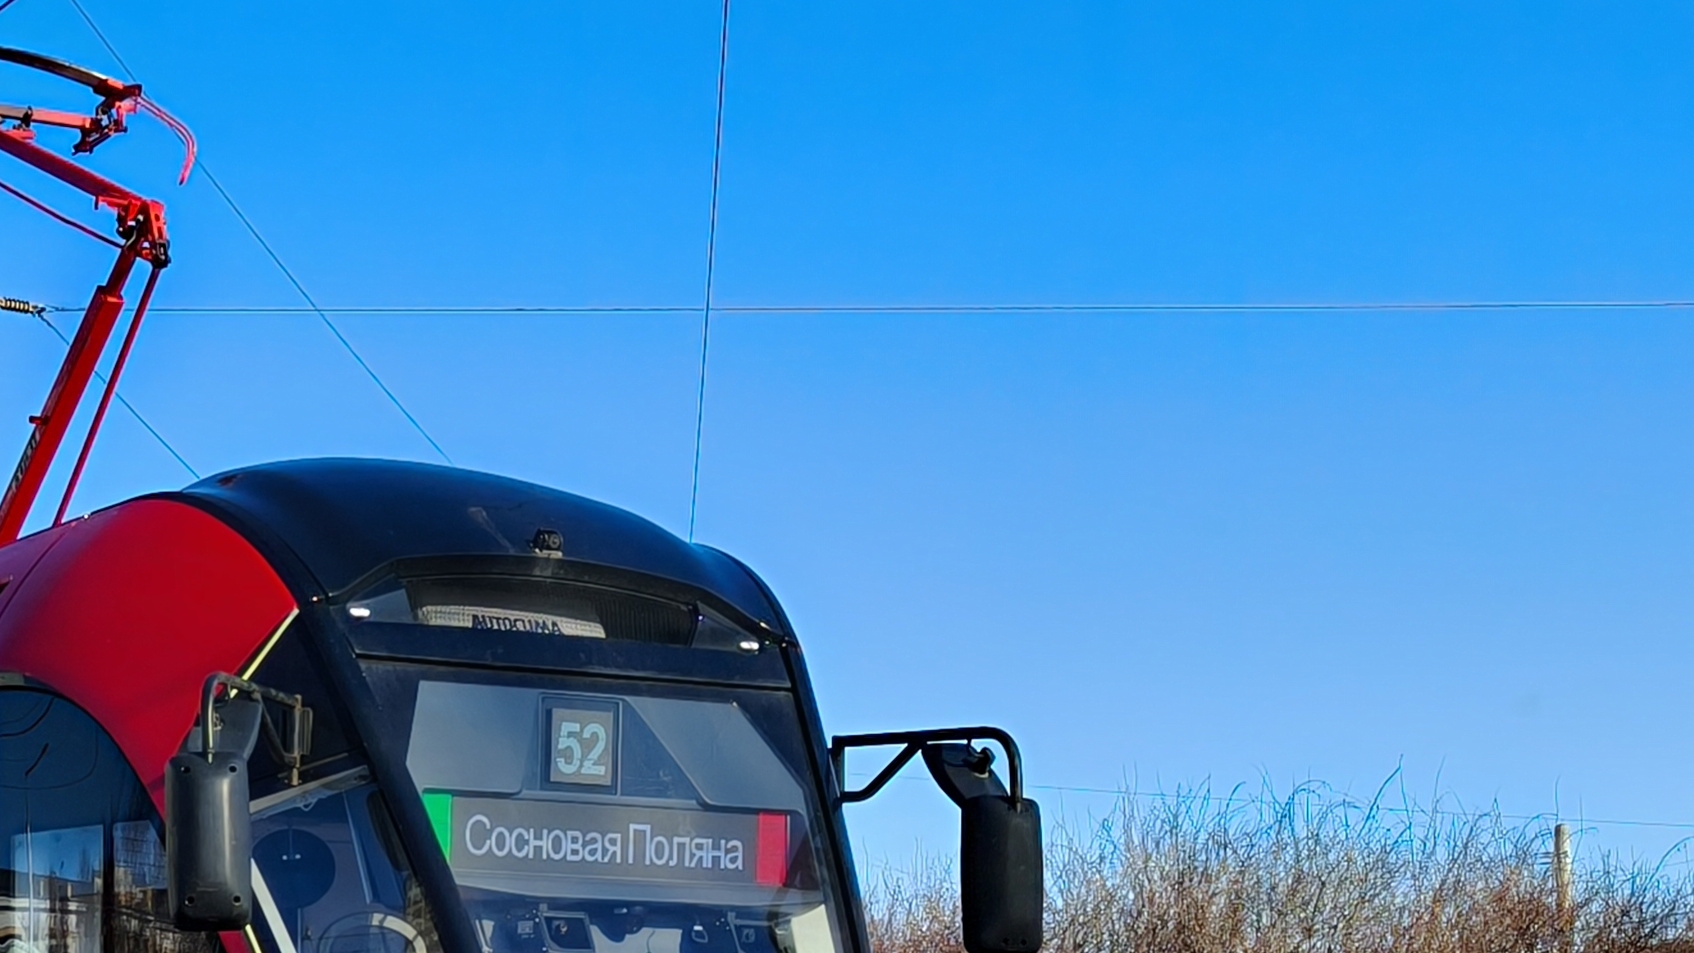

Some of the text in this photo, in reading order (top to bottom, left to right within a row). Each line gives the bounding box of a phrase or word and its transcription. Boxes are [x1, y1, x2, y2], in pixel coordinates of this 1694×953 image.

[556, 722, 607, 776] 52
[465, 814, 744, 871] Сосновая Поляна
